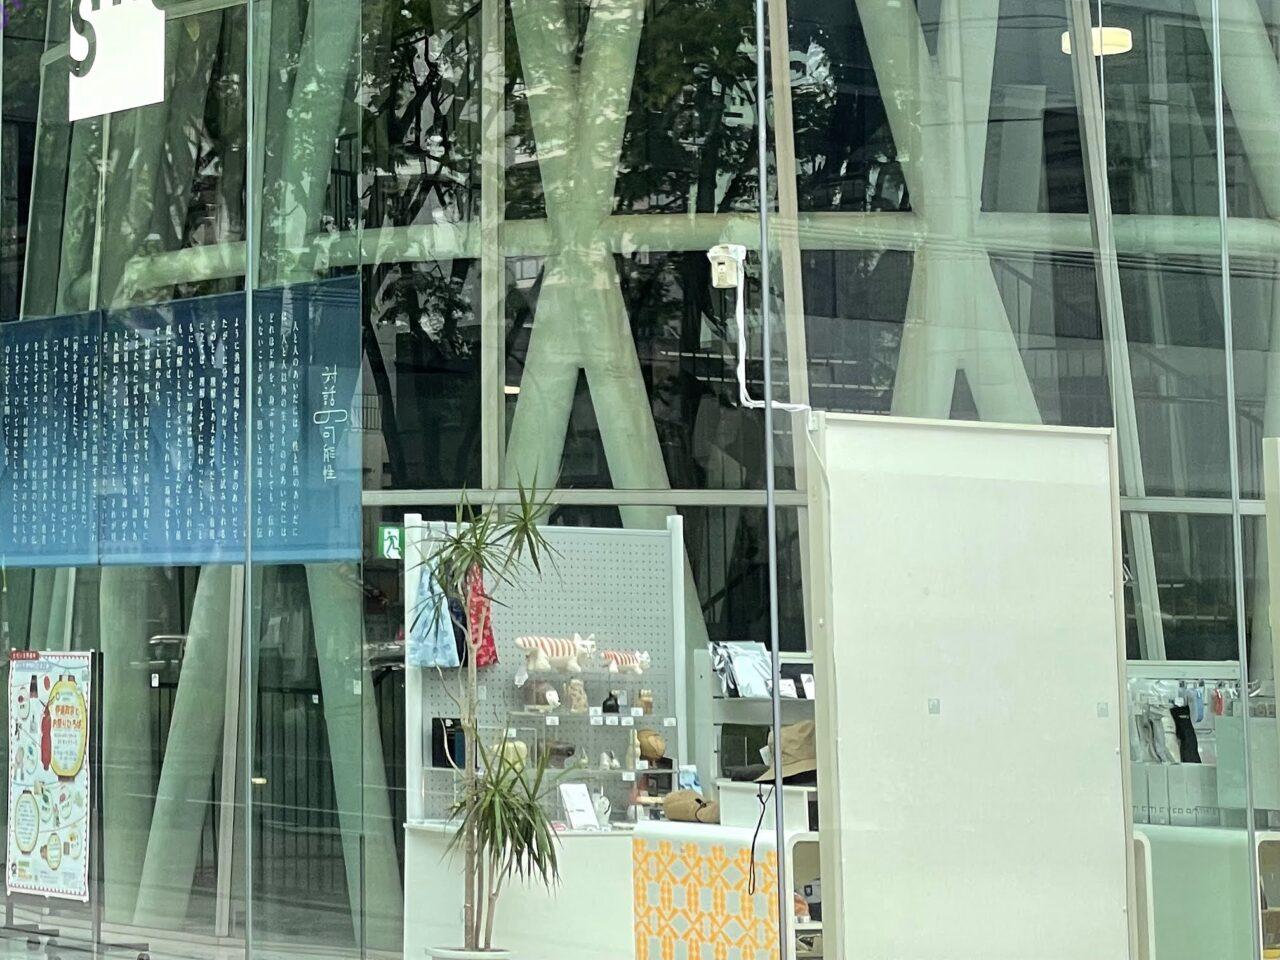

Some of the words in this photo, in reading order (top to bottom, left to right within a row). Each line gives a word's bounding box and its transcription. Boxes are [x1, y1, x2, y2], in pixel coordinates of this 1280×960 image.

[313, 364, 348, 483] 対話の可能性
